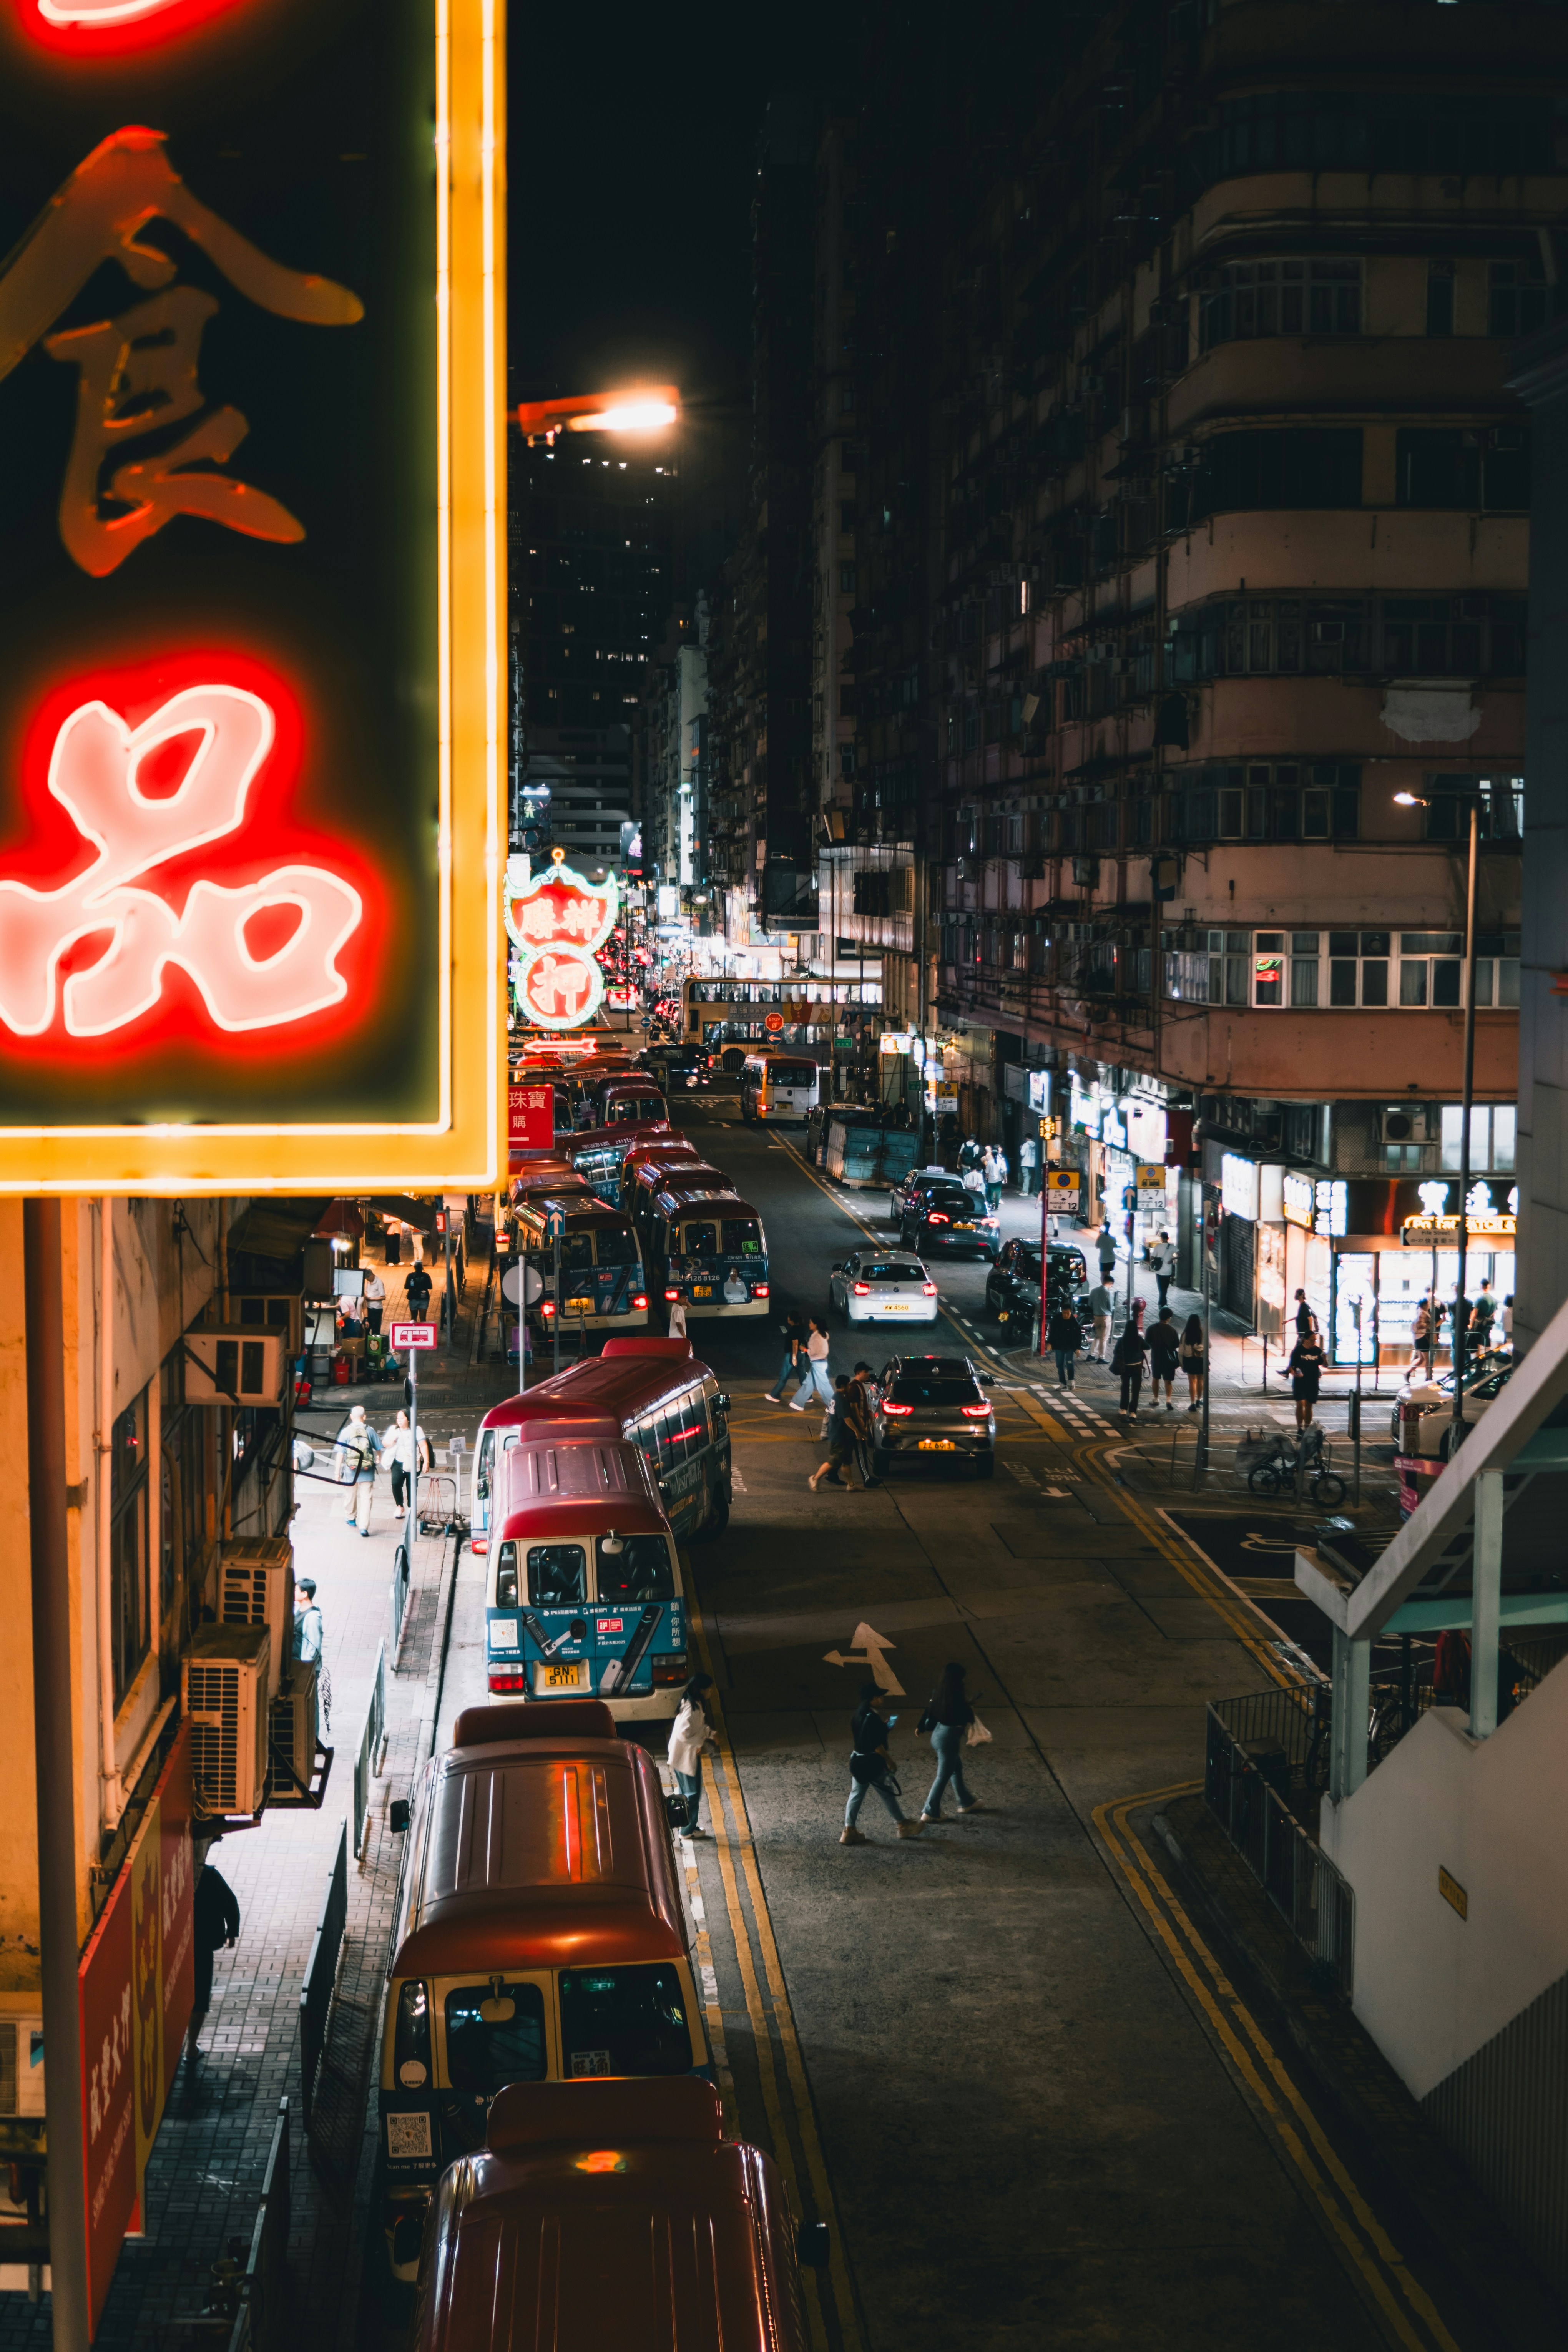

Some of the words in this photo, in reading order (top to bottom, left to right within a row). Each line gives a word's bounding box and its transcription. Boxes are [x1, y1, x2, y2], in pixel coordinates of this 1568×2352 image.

[0, 0, 365, 1038] 食品
[530, 956, 589, 1015] 押
[508, 1091, 546, 1109] 珠寶
[513, 1116, 526, 1128] 購
[553, 1667, 569, 1676] GN
[549, 1675, 574, 1684] 5111
